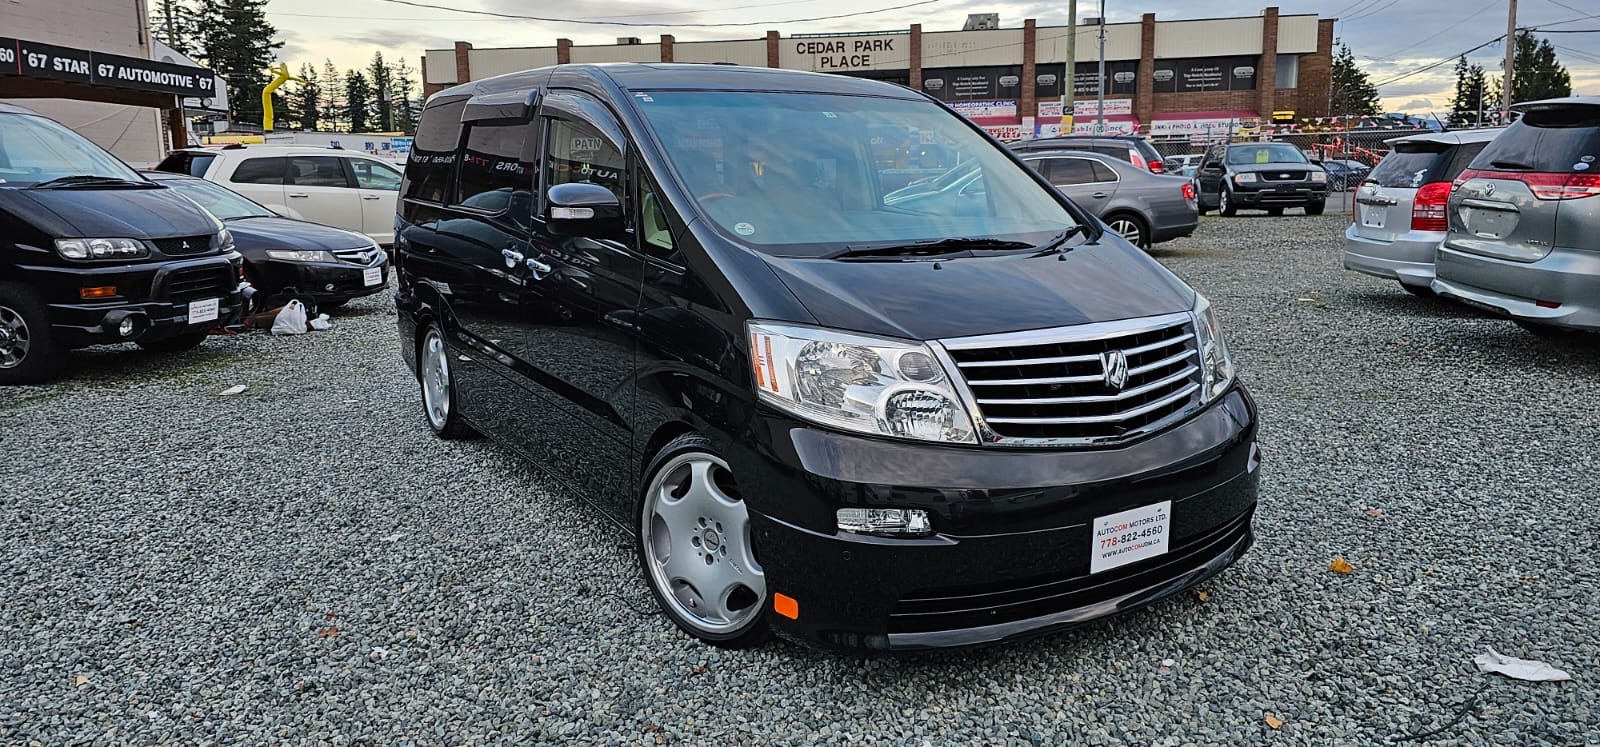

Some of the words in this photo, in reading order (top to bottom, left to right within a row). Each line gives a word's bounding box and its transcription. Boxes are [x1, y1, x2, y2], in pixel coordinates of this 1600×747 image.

[796, 41, 846, 54] CEDAR
[854, 38, 894, 52] PARK
[53, 57, 90, 75] STAR
[821, 54, 871, 68] PLACE
[98, 63, 115, 78] 67
[118, 66, 194, 88] AUTOMOTIVE
[1097, 523, 1128, 537] AUTOCOM
[1129, 516, 1154, 528] MOTORS
[1155, 513, 1168, 523] LTD.
[1100, 525, 1163, 549] 778-822-4560
